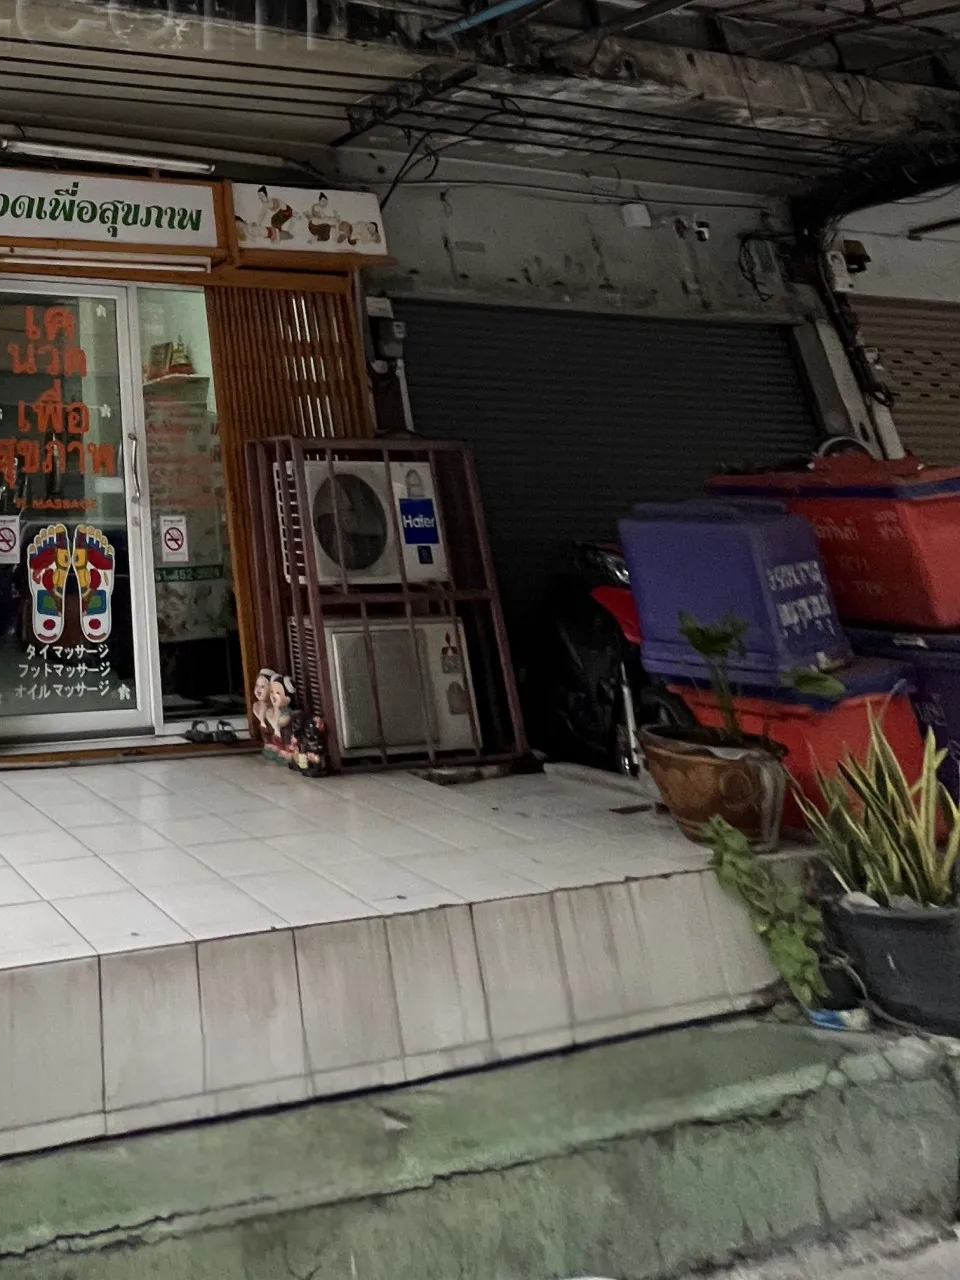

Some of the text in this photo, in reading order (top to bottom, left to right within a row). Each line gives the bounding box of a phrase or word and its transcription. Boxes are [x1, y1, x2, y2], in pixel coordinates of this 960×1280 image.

[24, 305, 76, 341] เค
[7, 343, 87, 377] นวด
[17, 378, 90, 435] เพื่อ
[402, 514, 435, 529] Haier
[26, 644, 109, 660] タイマッサージ
[18, 661, 111, 678] フットマッサージ
[15, 680, 110, 700] オイルマッサージ
